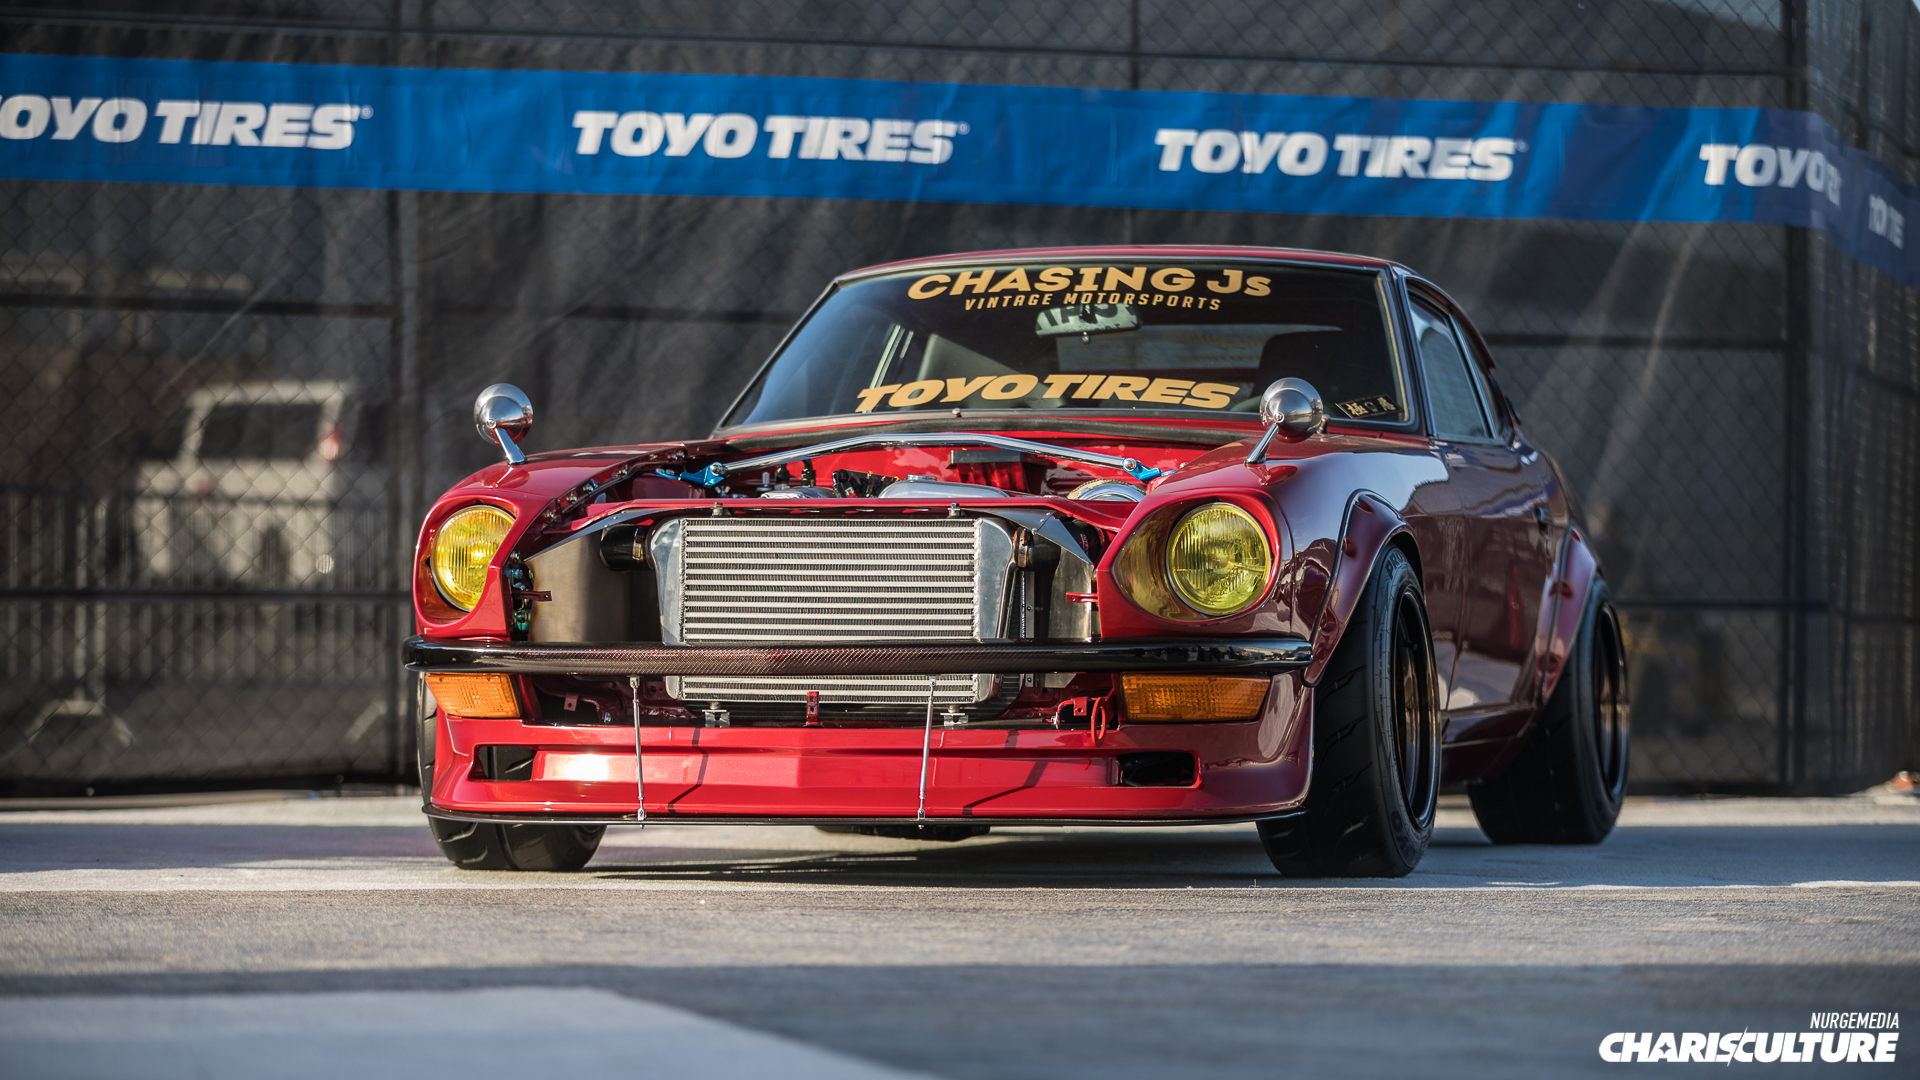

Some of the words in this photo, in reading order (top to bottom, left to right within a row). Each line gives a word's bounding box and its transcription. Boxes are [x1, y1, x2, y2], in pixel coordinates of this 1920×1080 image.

[0, 95, 148, 143] OYO
[155, 101, 361, 150] TIRES
[572, 110, 758, 158] TOYO
[764, 115, 956, 164] TIRES
[1154, 128, 1328, 176] TOYO
[1334, 134, 1517, 181] TIRES
[1699, 143, 1826, 192] TOYO
[907, 266, 1196, 300] CHASING
[964, 292, 1053, 311] VINTAGE
[1063, 291, 1222, 311] MOTORSPORTS
[854, 374, 1038, 413] TOYO
[1042, 374, 1240, 409] TIRES
